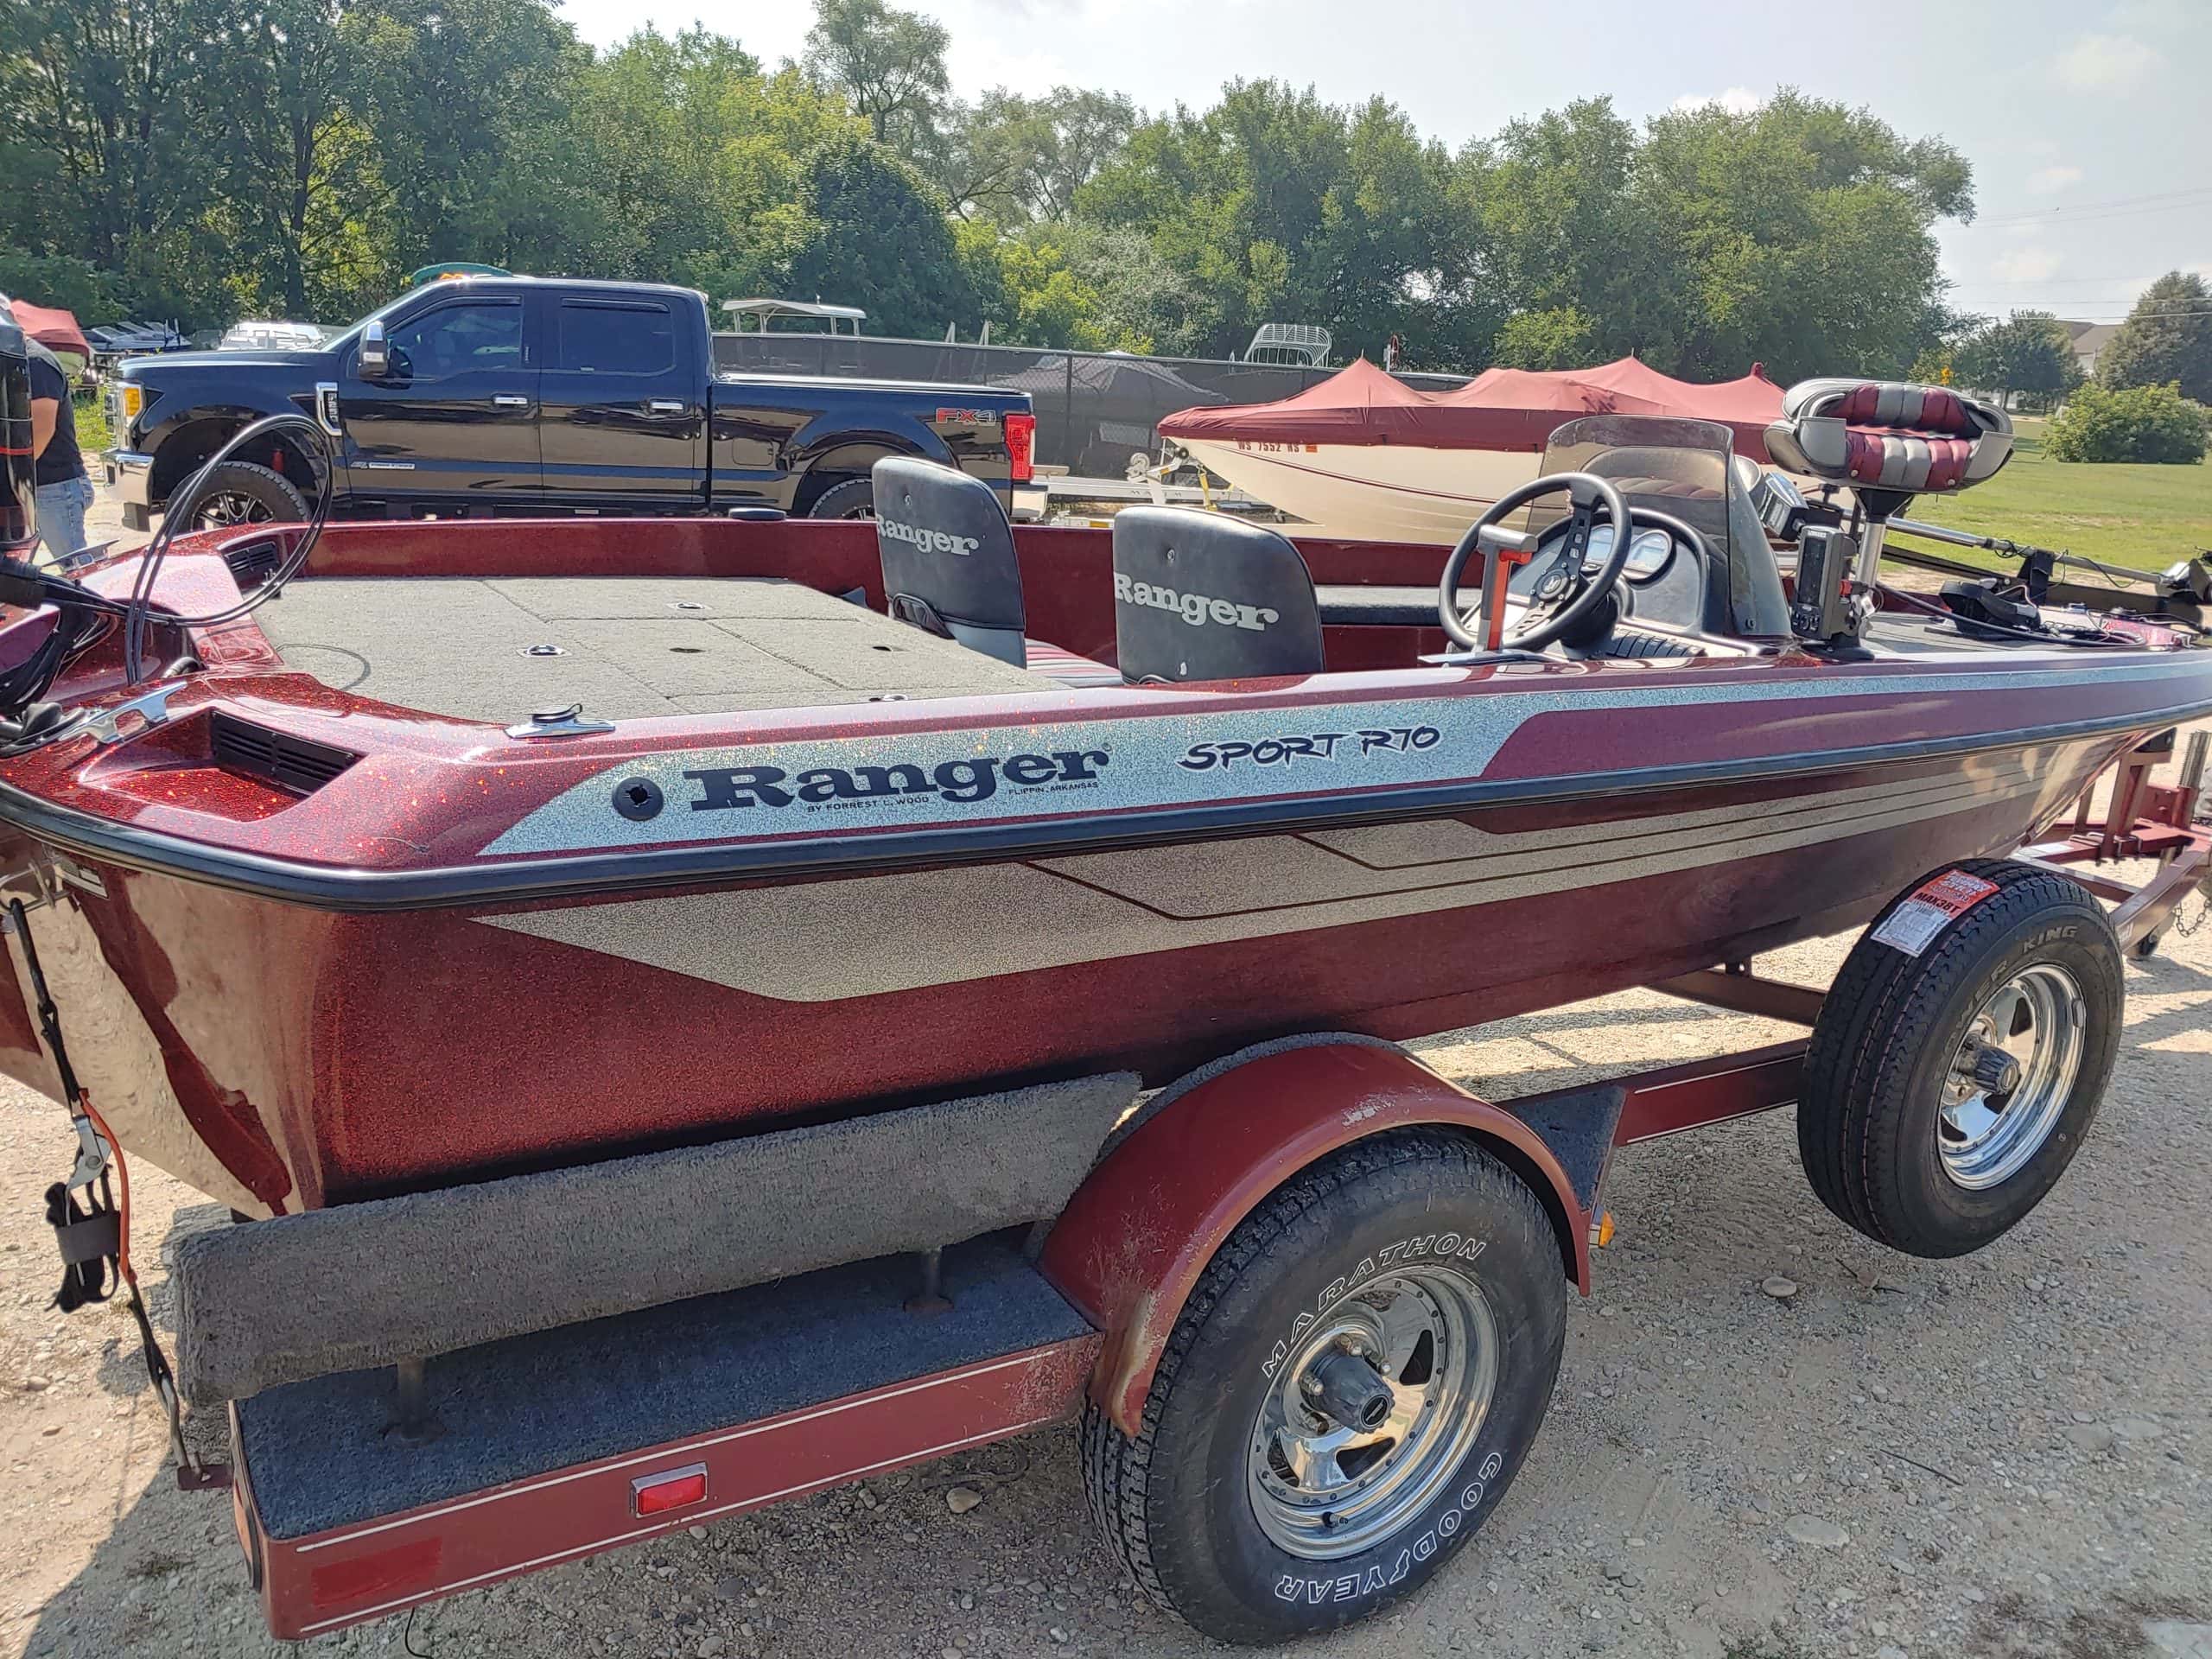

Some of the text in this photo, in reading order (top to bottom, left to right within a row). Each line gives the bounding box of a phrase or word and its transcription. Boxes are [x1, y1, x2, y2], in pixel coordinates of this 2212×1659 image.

[936, 407, 996, 424] FX4
[875, 513, 979, 556] Ranger
[1113, 571, 1279, 632] Ranger
[1176, 733, 1350, 771] SPORT
[683, 749, 1110, 812] Ranger
[1050, 781, 1099, 792] ARKANSAS
[807, 804, 822, 813] BY
[826, 800, 878, 810] FORREST
[896, 796, 929, 806] WOOD
[2023, 925, 2079, 953] KING
[1262, 1233, 1487, 1379] MARATHON
[1274, 1452, 1503, 1605] GOODYEAR
